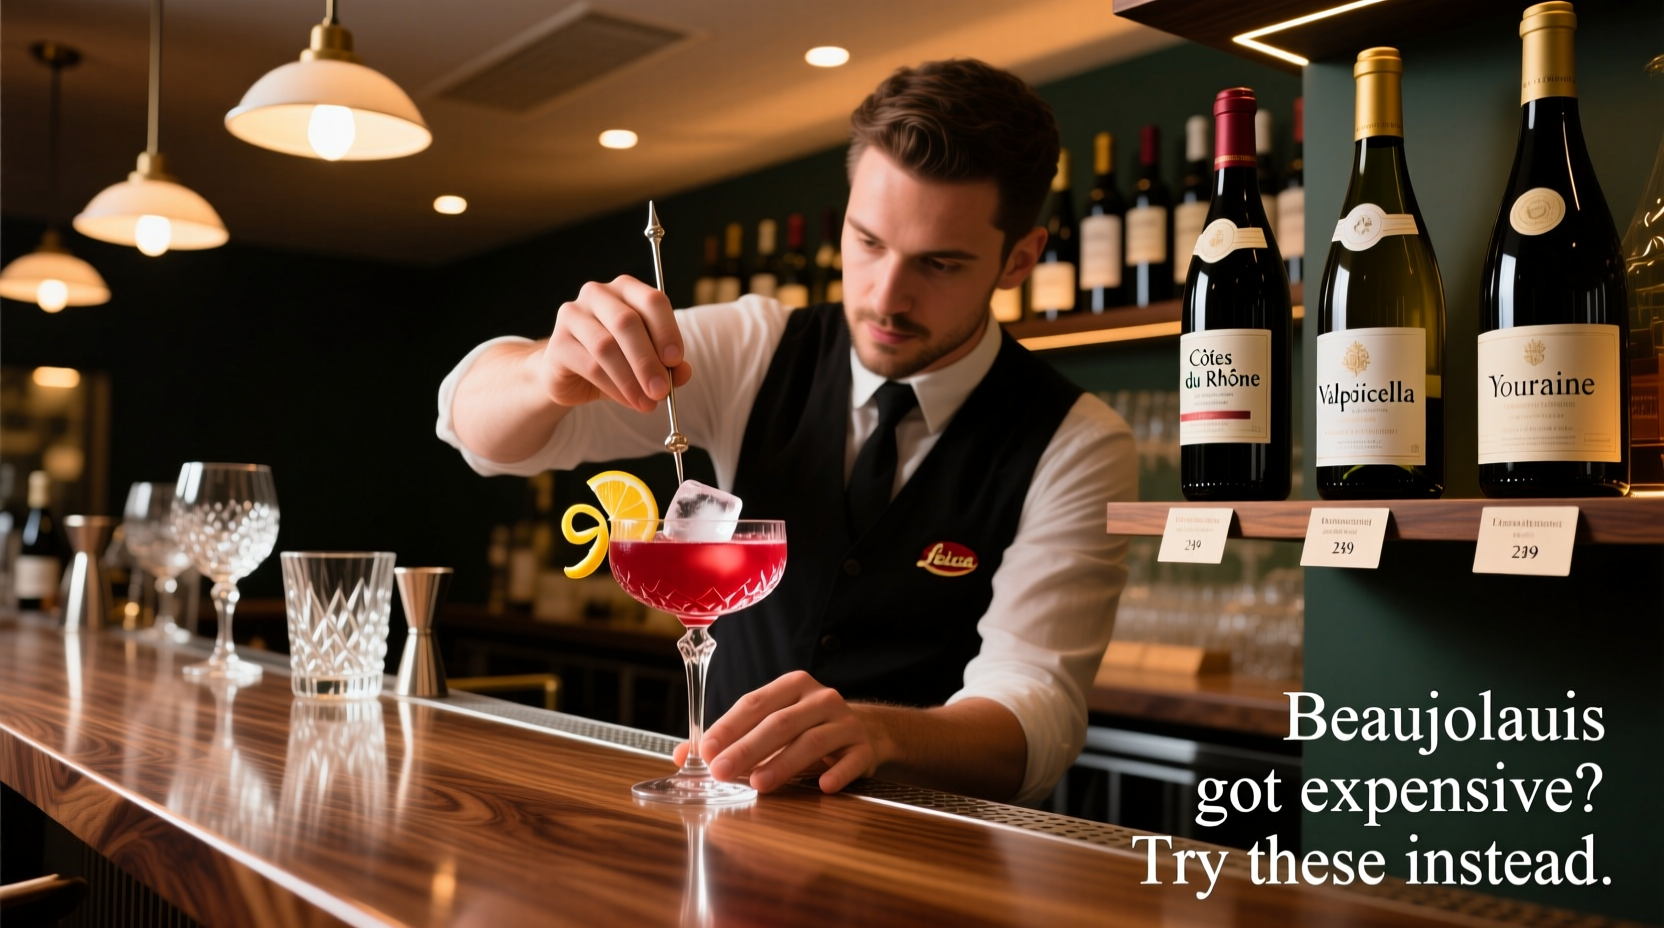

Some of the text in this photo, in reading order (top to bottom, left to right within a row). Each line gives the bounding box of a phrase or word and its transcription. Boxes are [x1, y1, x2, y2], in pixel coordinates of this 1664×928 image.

[1185, 368, 1261, 389] du Rhône
[1488, 371, 1596, 398] Youraine
